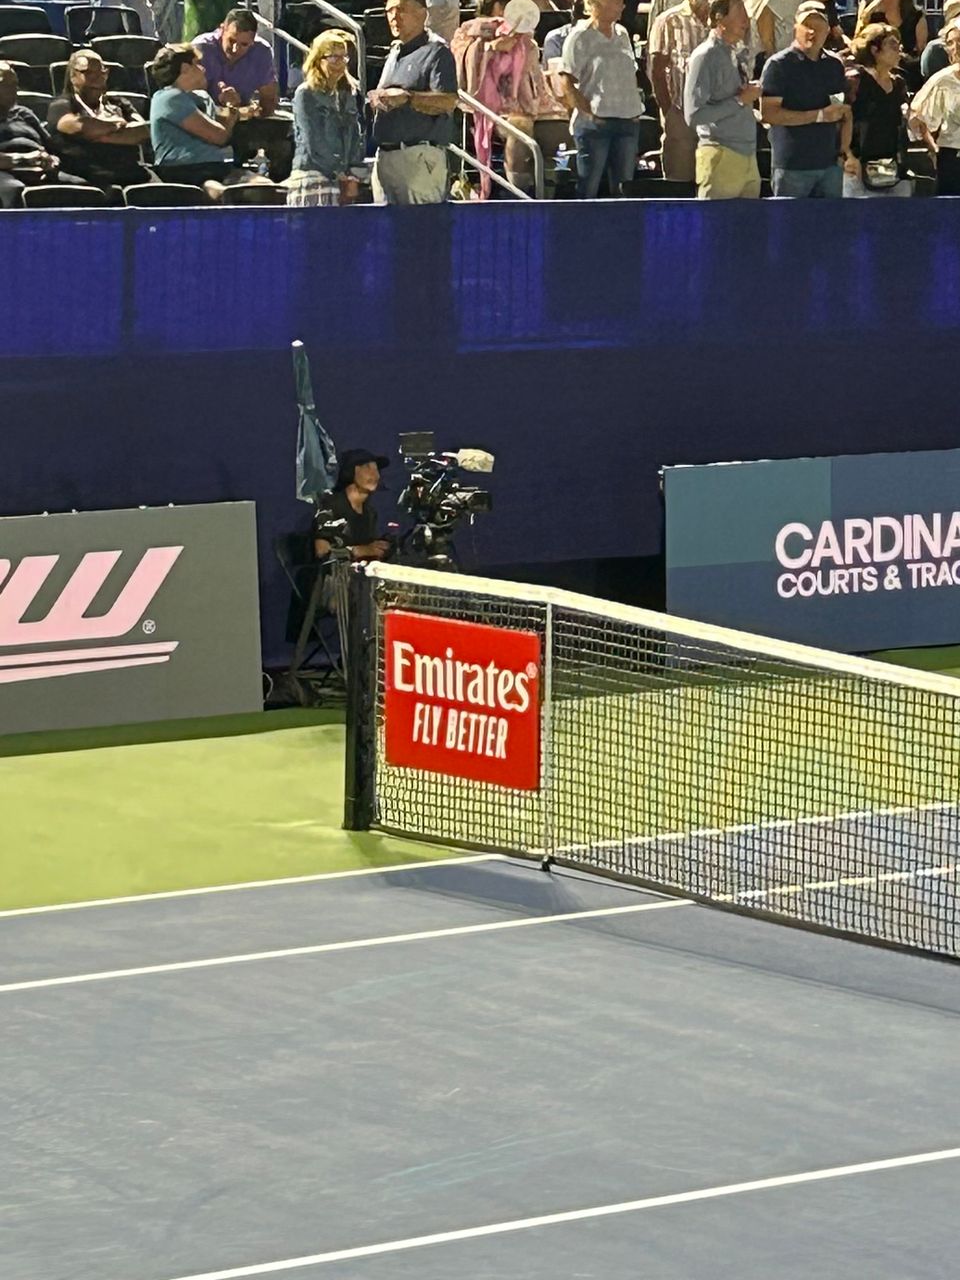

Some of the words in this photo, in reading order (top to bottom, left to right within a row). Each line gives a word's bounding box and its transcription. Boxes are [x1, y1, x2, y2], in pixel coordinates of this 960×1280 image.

[776, 567, 878, 599] COURTS
[883, 565, 902, 590] &
[392, 640, 530, 713] Emirates
[412, 702, 443, 746] FLY
[445, 708, 509, 760] BETTER
